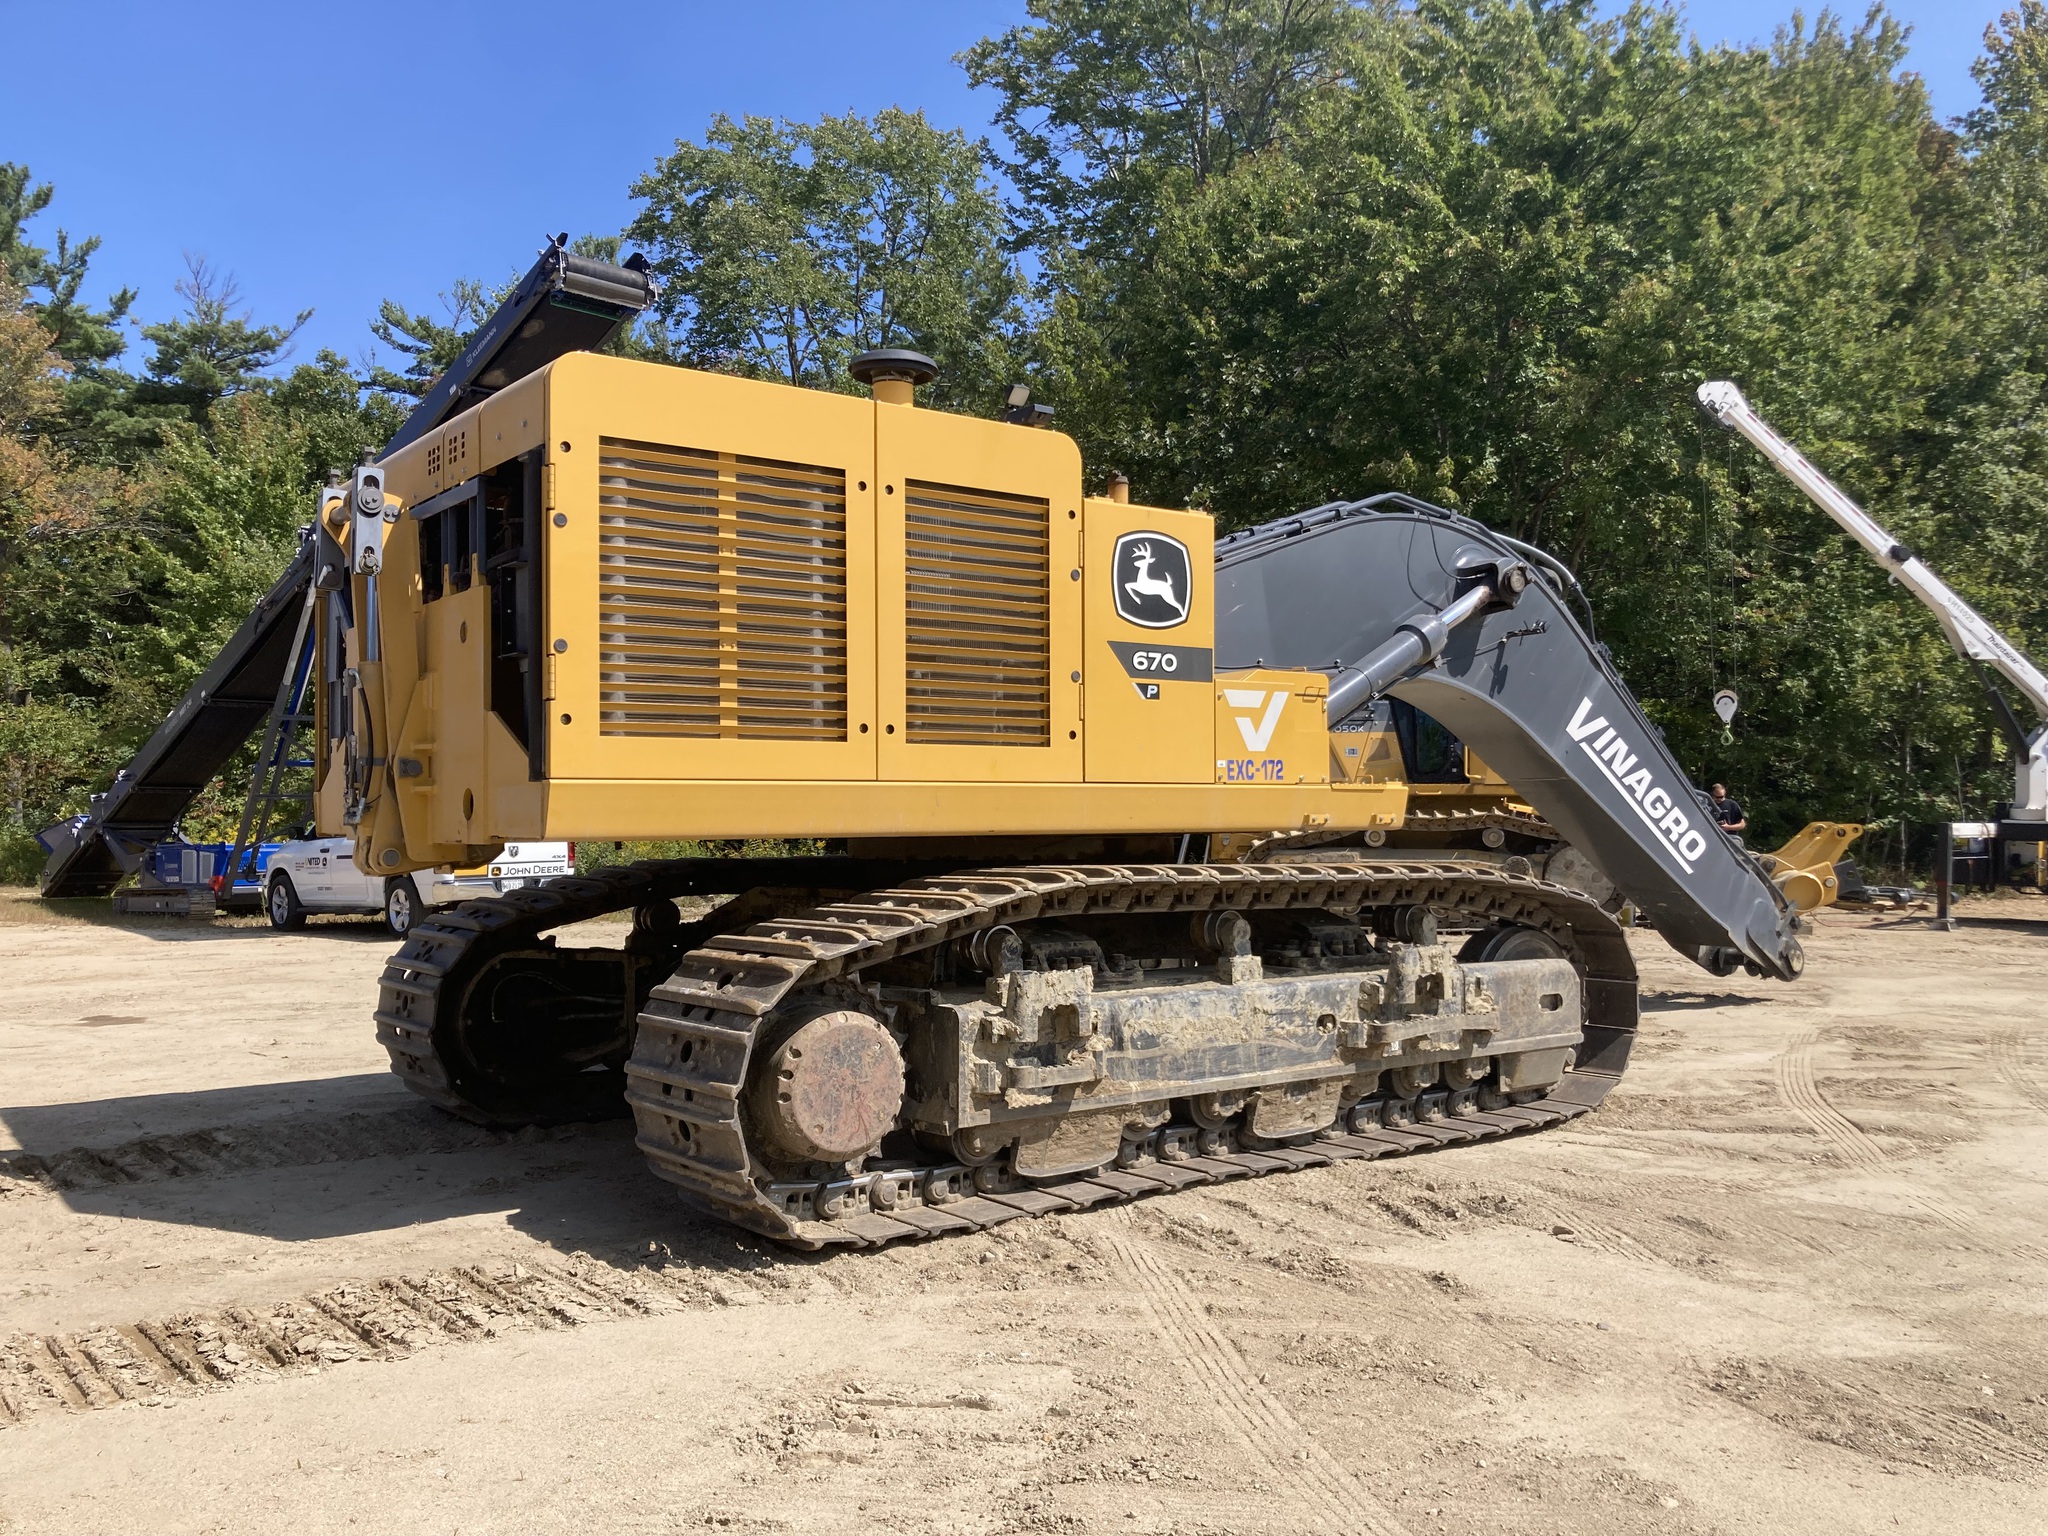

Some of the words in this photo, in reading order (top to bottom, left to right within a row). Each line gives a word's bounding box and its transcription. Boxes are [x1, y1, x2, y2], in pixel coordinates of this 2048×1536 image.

[1985, 634, 2020, 665] Maintainer
[1131, 651, 1178, 673] 670
[1146, 685, 1158, 699] P
[1227, 759, 1284, 781] EXC-172
[1565, 696, 1706, 862] VINAGRO
[503, 866, 531, 876] JOHN
[533, 865, 565, 875] DEERE
